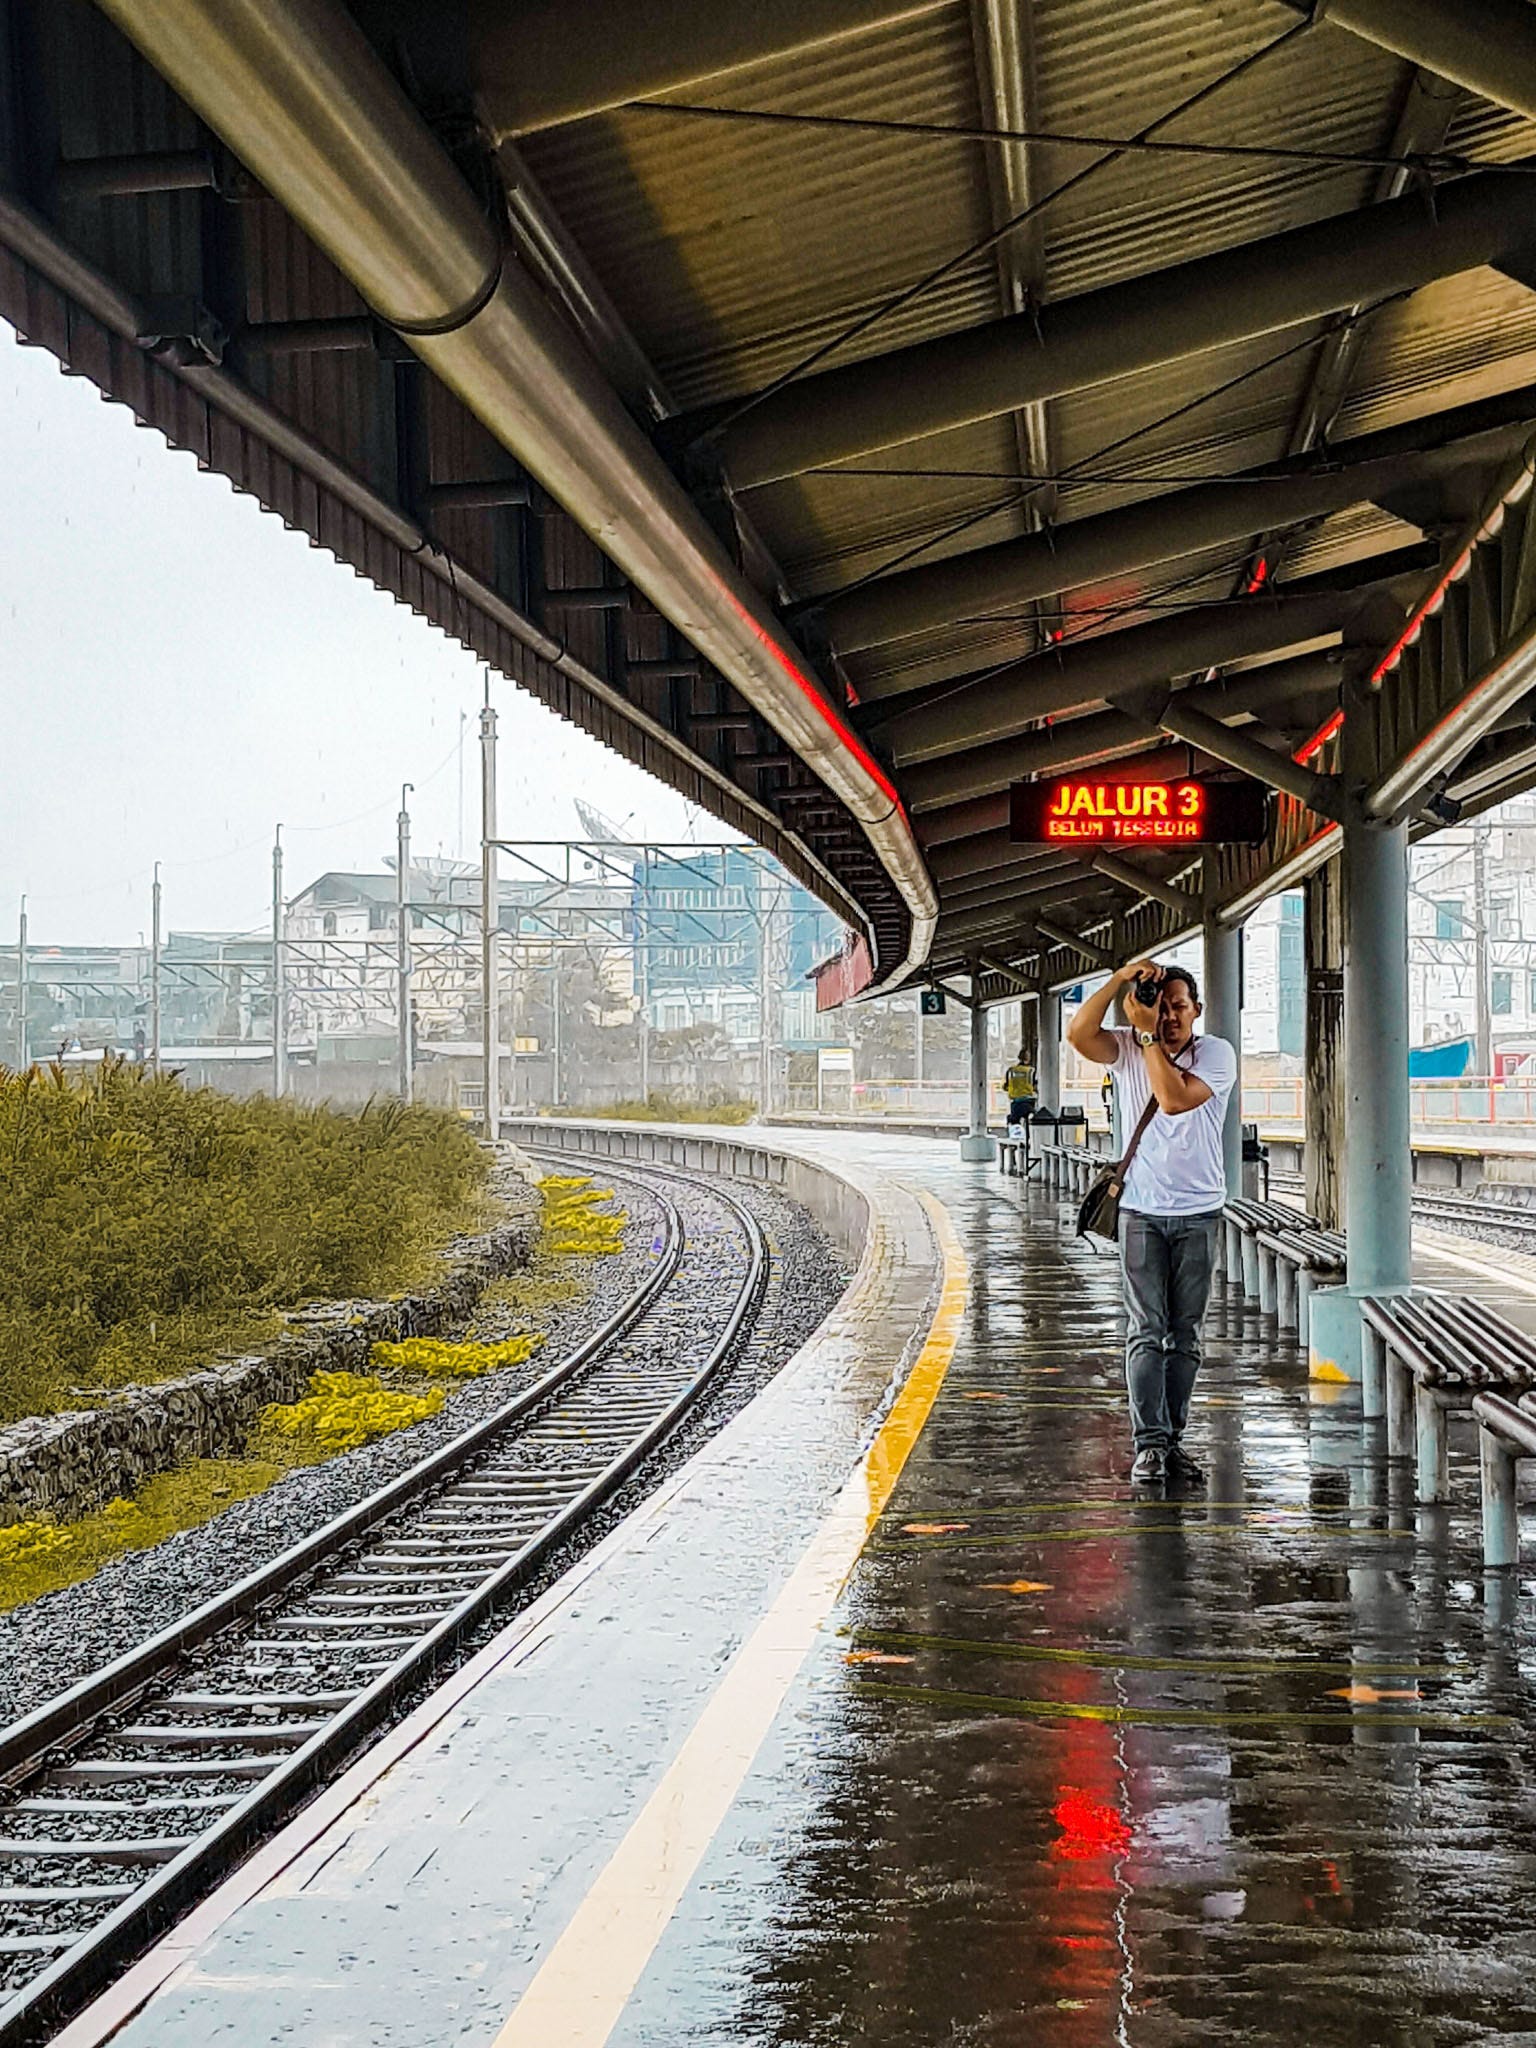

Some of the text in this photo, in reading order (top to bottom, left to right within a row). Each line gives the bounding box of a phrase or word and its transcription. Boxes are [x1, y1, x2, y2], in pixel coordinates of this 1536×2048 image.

[1051, 785, 1200, 816] JALUR 3
[1048, 820, 1103, 836] BELUM
[1064, 985, 1077, 1000] 2
[927, 994, 939, 1012] 3
